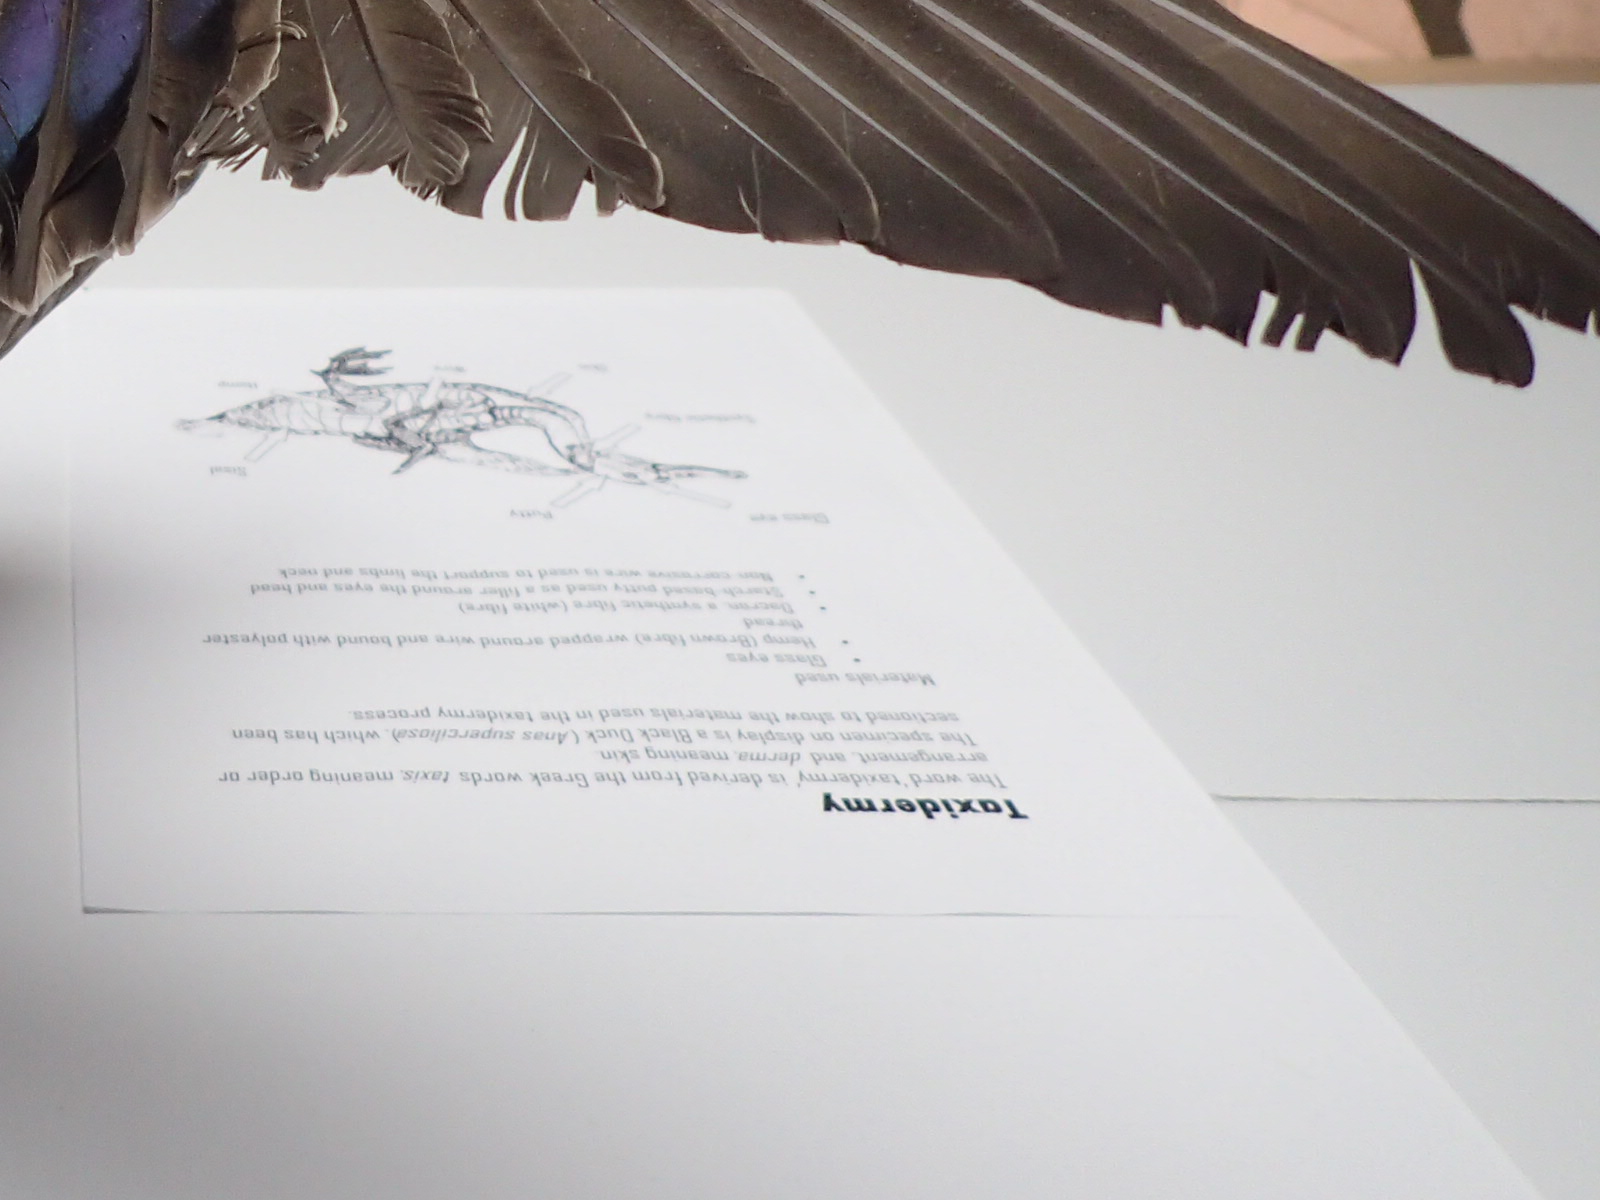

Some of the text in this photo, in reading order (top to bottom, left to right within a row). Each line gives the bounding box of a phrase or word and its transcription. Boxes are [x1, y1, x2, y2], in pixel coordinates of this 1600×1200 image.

[279, 567, 318, 578] neck
[324, 567, 353, 578] and
[359, 567, 405, 579] limbs
[411, 570, 437, 580] the
[444, 568, 509, 581] support
[516, 570, 532, 579] to
[538, 567, 579, 579] used
[584, 567, 598, 578] is
[605, 568, 641, 578] wire
[250, 584, 291, 595] head
[298, 584, 327, 594] and
[334, 581, 373, 594] eyes
[380, 584, 406, 595] the
[412, 585, 472, 595] around
[480, 586, 520, 598] filler
[541, 584, 560, 593] as
[567, 584, 607, 594] used
[614, 582, 657, 594] putty
[458, 602, 507, 615] fibre)
[512, 600, 567, 613] (white
[574, 600, 616, 612] fibre
[623, 599, 701, 612] synthetic
[743, 617, 803, 629] thread
[203, 632, 816, 648] Hemp (Brown fibre) wrapped around wire and bound with polyester
[726, 651, 827, 667] Glass eyes
[794, 673, 935, 687] Materials used
[348, 706, 959, 725] sectioned to show the materials used in the taxidermy process.
[232, 729, 277, 743] been
[284, 729, 318, 743] has
[325, 730, 380, 744] which
[522, 730, 580, 744] (Anas
[585, 729, 634, 743] Duck
[639, 728, 692, 744] Black
[713, 730, 732, 743] is
[737, 729, 805, 745] display
[811, 731, 834, 743] on
[842, 730, 933, 745] specimen
[940, 731, 977, 747] The
[645, 746, 729, 763] meaning
[810, 751, 846, 765] and
[218, 771, 240, 784] or
[248, 770, 304, 785] order
[310, 768, 393, 785] meaning
[460, 771, 522, 787] words
[529, 772, 589, 788] Greek
[595, 772, 626, 785] the
[631, 771, 682, 787] from
[688, 772, 762, 788] derived
[768, 773, 787, 788] is
[796, 770, 907, 788] 'taxidermy'
[909, 773, 962, 787] word
[967, 773, 1007, 789] The
[822, 793, 1029, 820] Taxidermy
